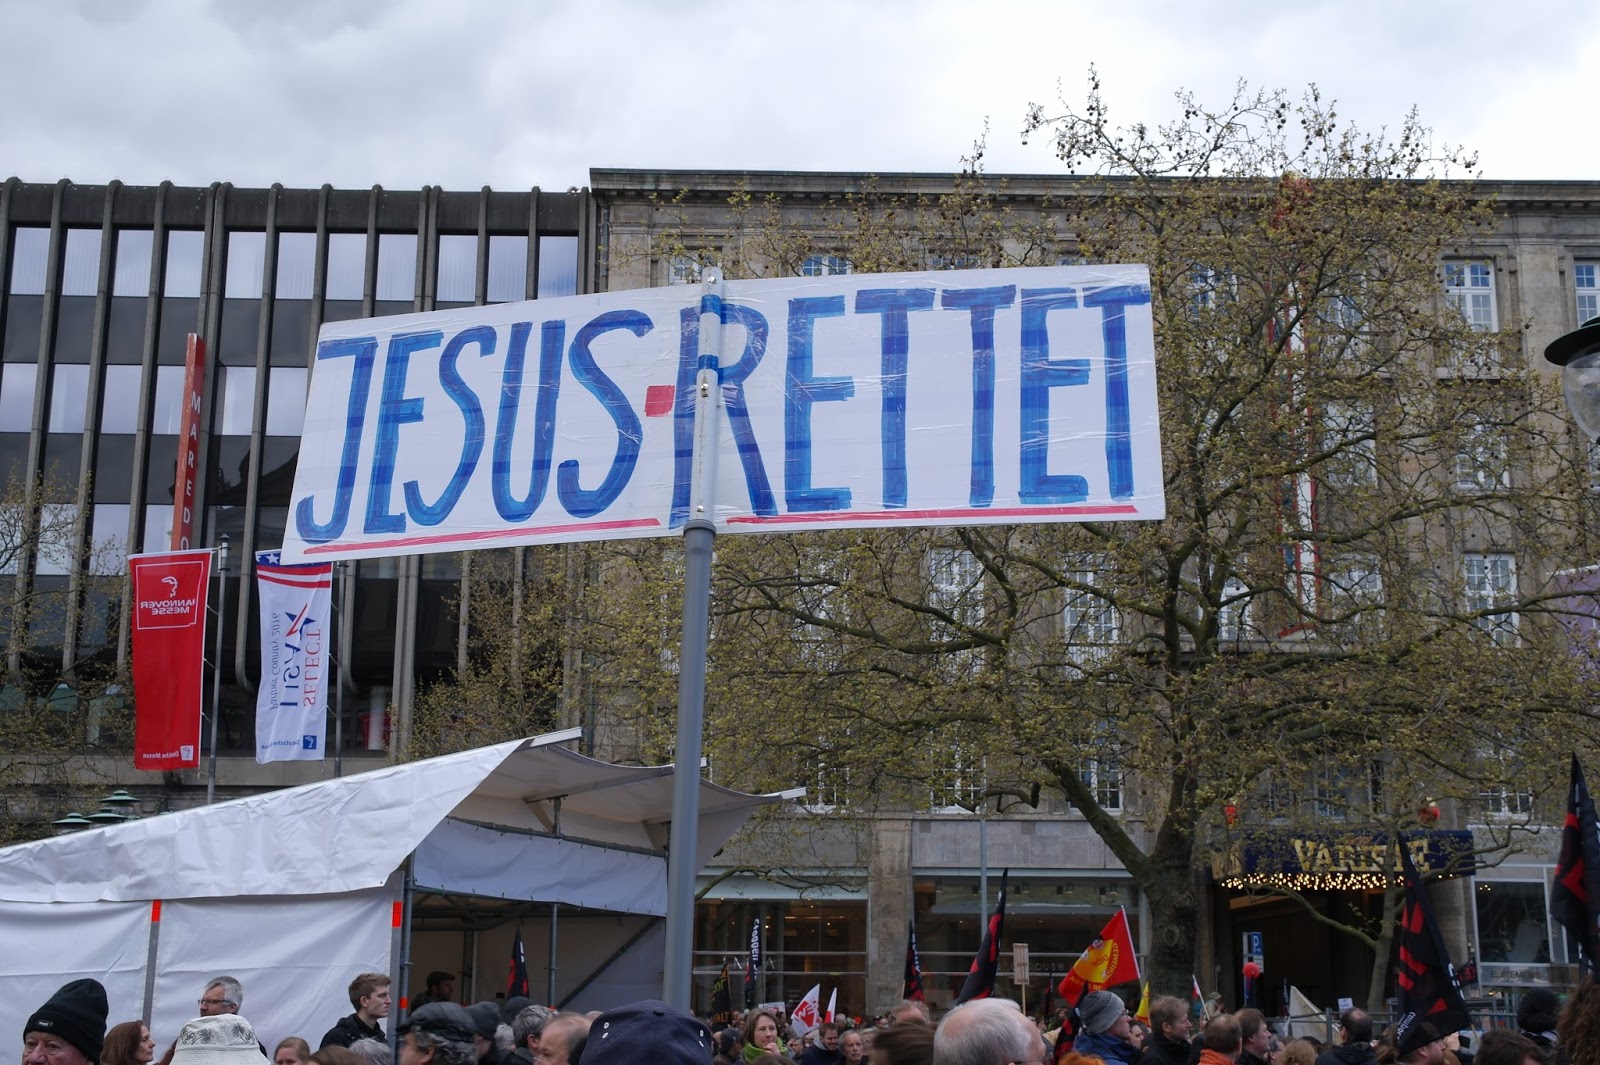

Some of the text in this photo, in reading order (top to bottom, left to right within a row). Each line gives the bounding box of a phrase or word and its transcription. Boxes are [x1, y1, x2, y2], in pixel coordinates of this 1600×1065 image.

[180, 391, 202, 550] MAREDO
[295, 284, 1152, 545] JESUS RETTET
